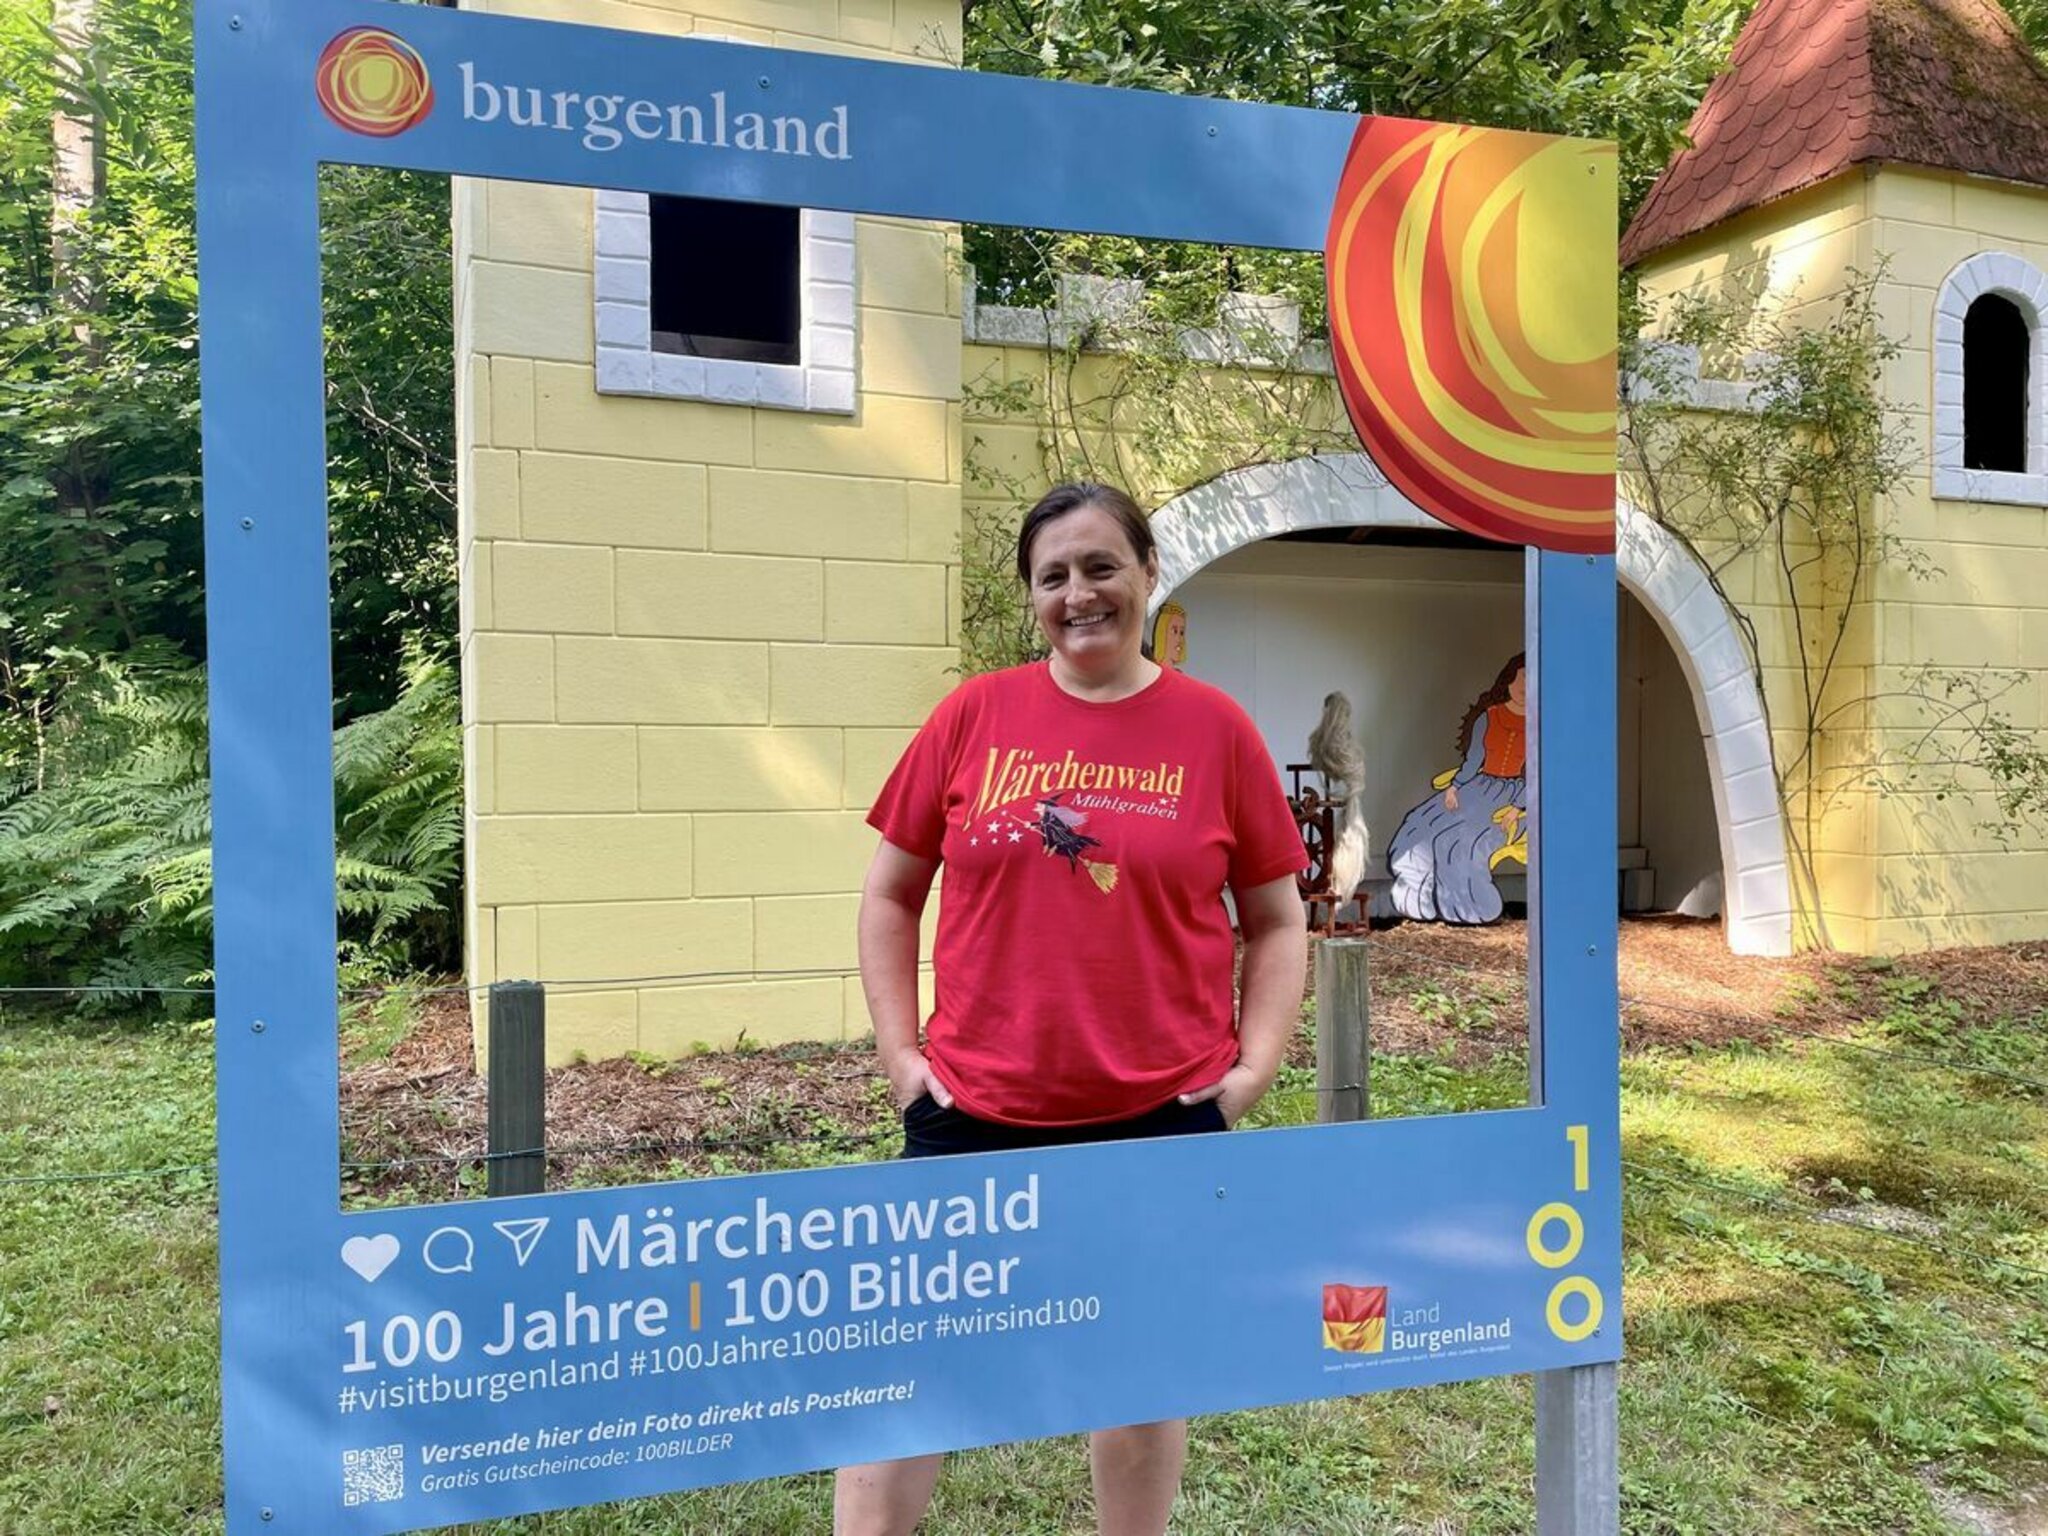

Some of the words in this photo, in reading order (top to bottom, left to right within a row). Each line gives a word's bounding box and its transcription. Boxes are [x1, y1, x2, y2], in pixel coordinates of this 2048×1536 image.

[458, 61, 852, 160] burgenland
[963, 747, 1184, 832] Märchenwald
[1071, 793, 1179, 820] Mühlgraben
[576, 1174, 1039, 1274] Märchenwald
[342, 1310, 462, 1373] 100
[482, 1291, 668, 1356] Jahre
[724, 1269, 830, 1327] 100
[850, 1250, 1020, 1312] Bilder
[1391, 1302, 1440, 1327] Land
[1391, 1318, 1511, 1352] Burgenland
[338, 1351, 619, 1413] #visitburgenland
[629, 1318, 929, 1376] #100Jahre100Bilder
[935, 1296, 1100, 1339] #wirsind100
[421, 1433, 530, 1464] Versende
[536, 1427, 583, 1449] hier
[588, 1418, 637, 1442] dein
[643, 1412, 692, 1434] Foto
[698, 1401, 764, 1427] direkt
[769, 1396, 800, 1417] als
[805, 1380, 915, 1412] Postkarte!
[421, 1467, 479, 1493] Gratis
[484, 1449, 630, 1482] Gutscheincode:
[635, 1432, 733, 1463] 100BILDER
